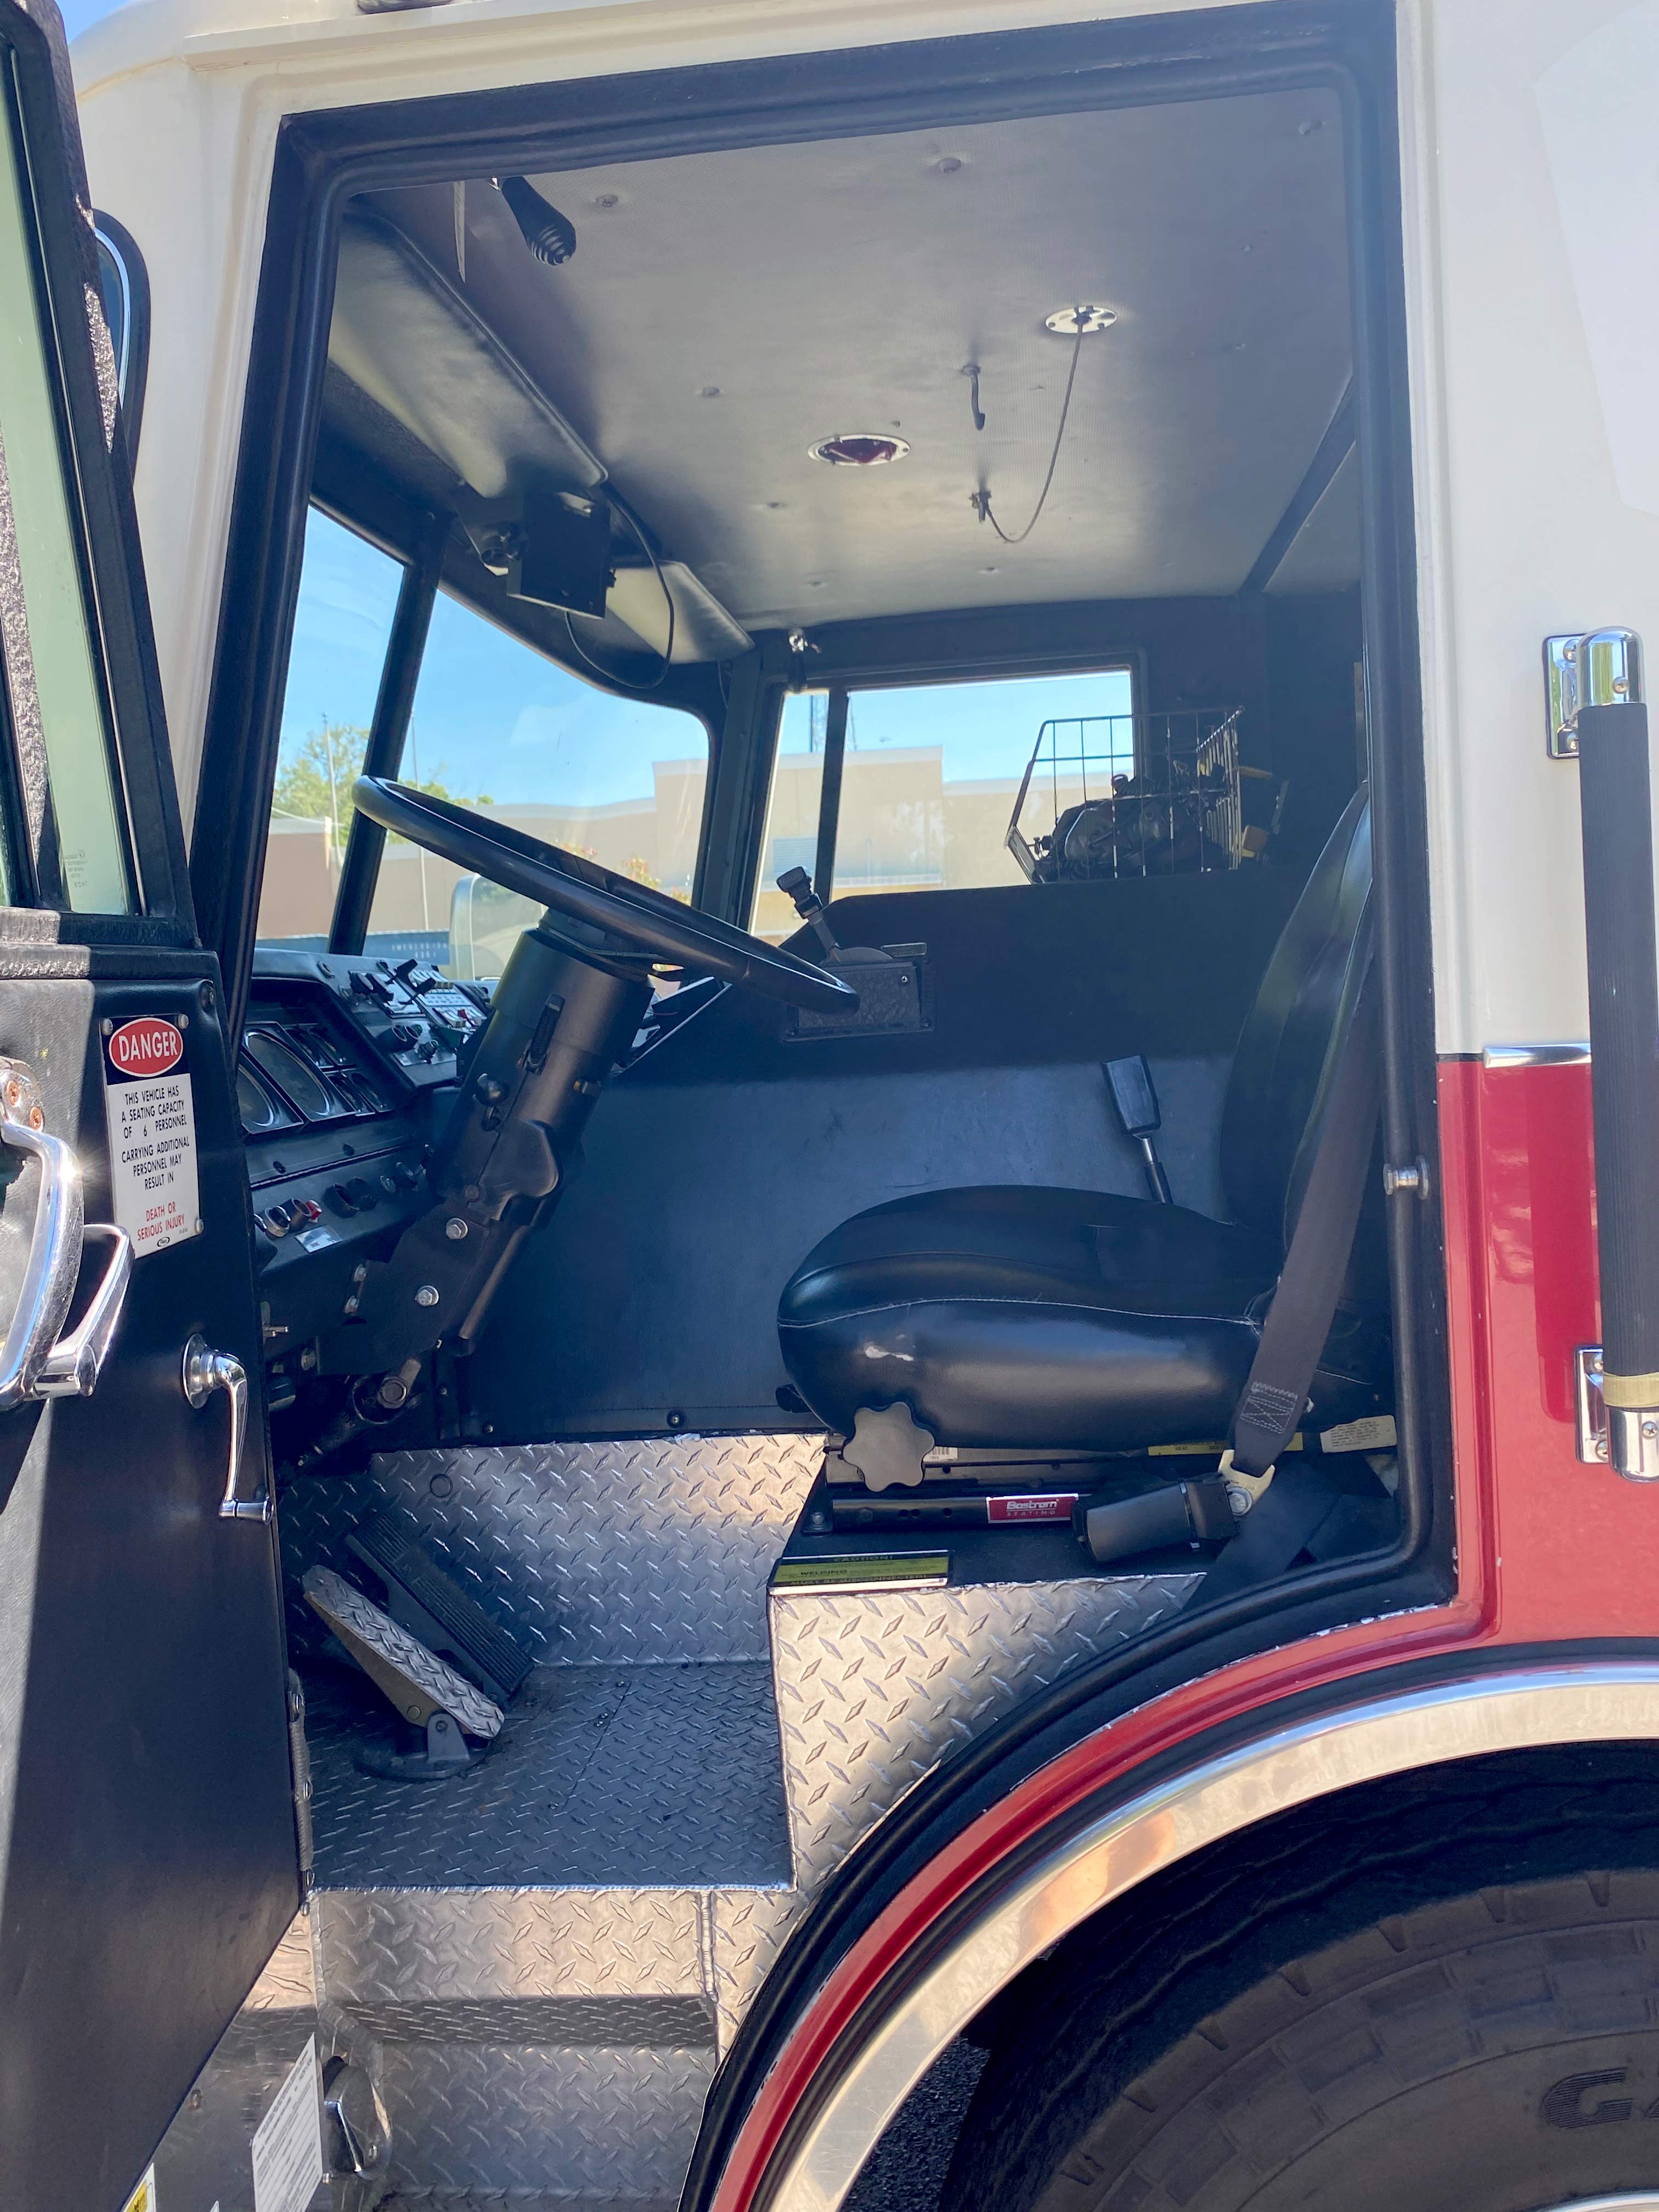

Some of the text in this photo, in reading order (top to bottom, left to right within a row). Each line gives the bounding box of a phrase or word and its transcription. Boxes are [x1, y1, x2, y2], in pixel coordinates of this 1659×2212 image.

[119, 1031, 178, 1062] DANGER
[125, 1085, 179, 1105] THIS VEHICLE HAS
[121, 1100, 184, 1123] A SEATING CAPACITY
[123, 1114, 187, 1138] OF 6 PERSONNEL
[122, 1136, 189, 1163] CARRYING ADDITIONAL
[133, 1153, 182, 1177] PERSONNEL MAY
[145, 1171, 174, 1190] RESULT IN
[146, 1201, 176, 1222] DEATH OR
[137, 1214, 185, 1241] SERIOUS INJURY
[1006, 1500, 1058, 1510] Bostrom
